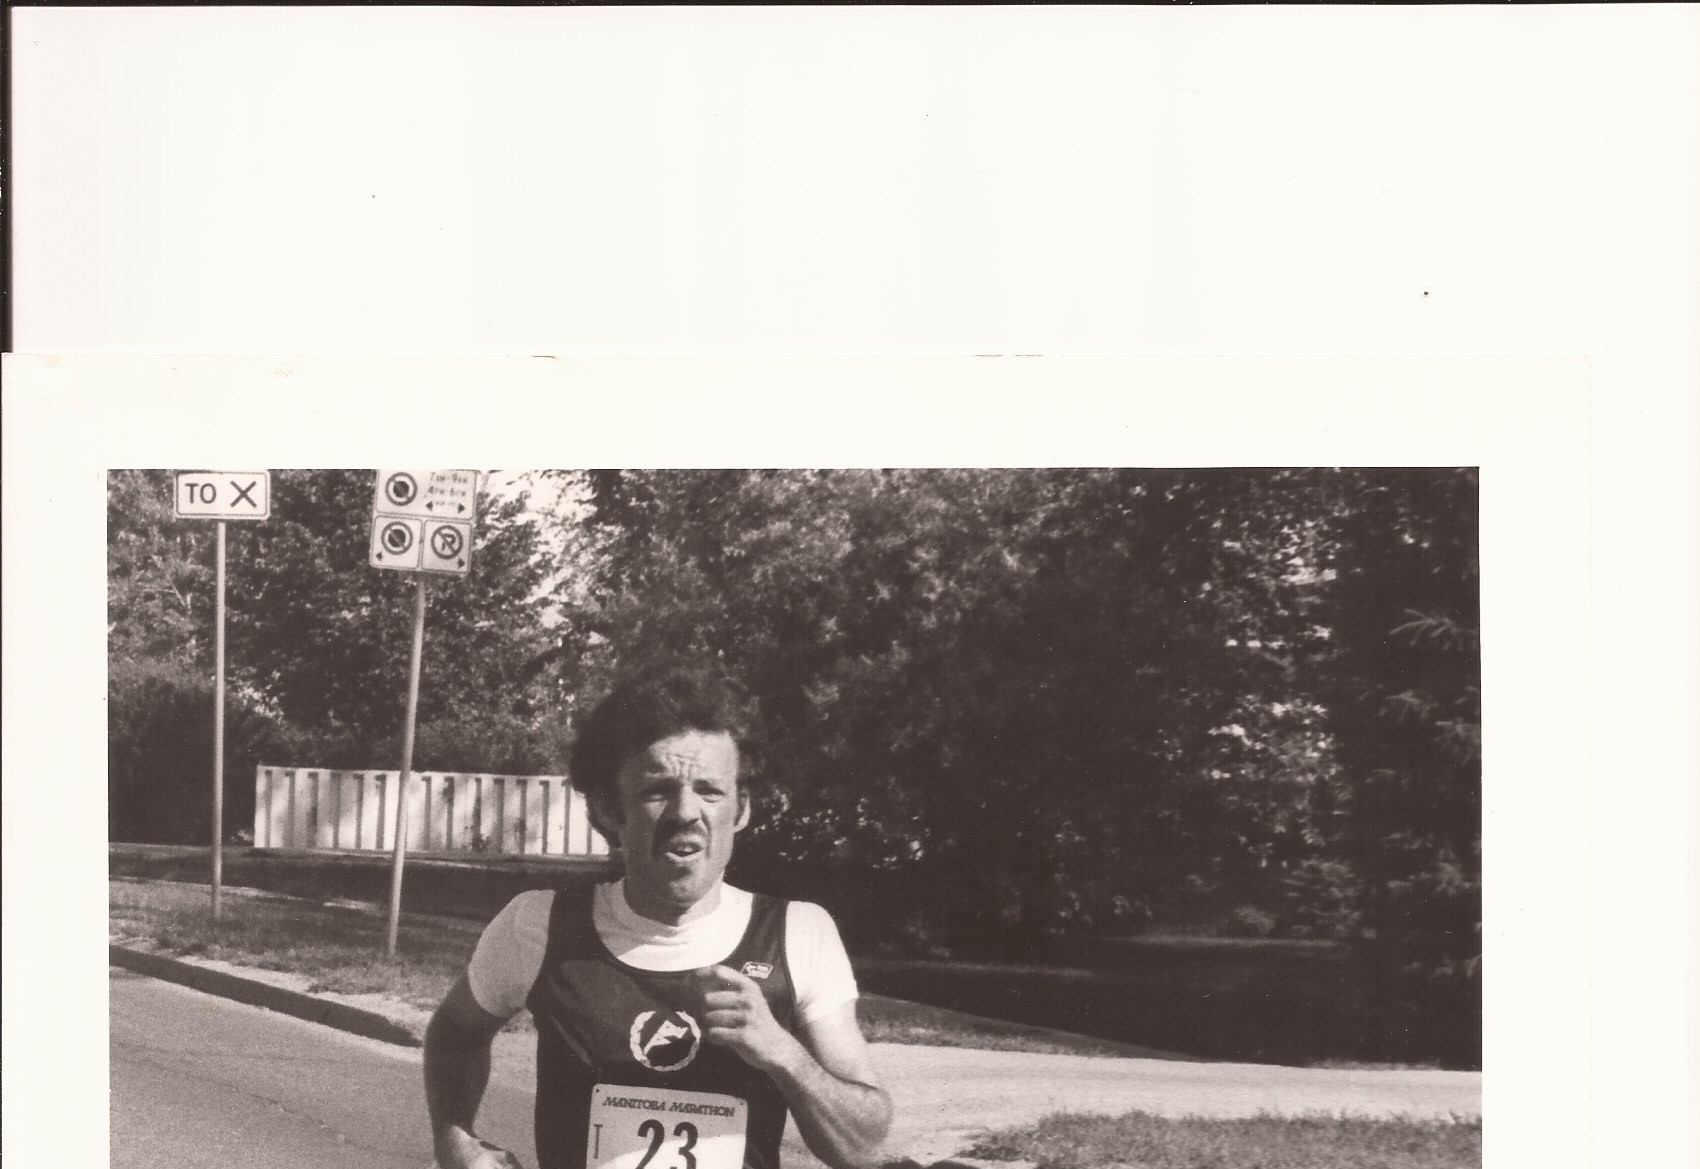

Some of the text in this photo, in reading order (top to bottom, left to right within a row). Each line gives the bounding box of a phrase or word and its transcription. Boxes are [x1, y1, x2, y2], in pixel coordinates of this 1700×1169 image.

[185, 483, 217, 504] TO
[602, 1097, 735, 1117] MANITOBA MARATHON
